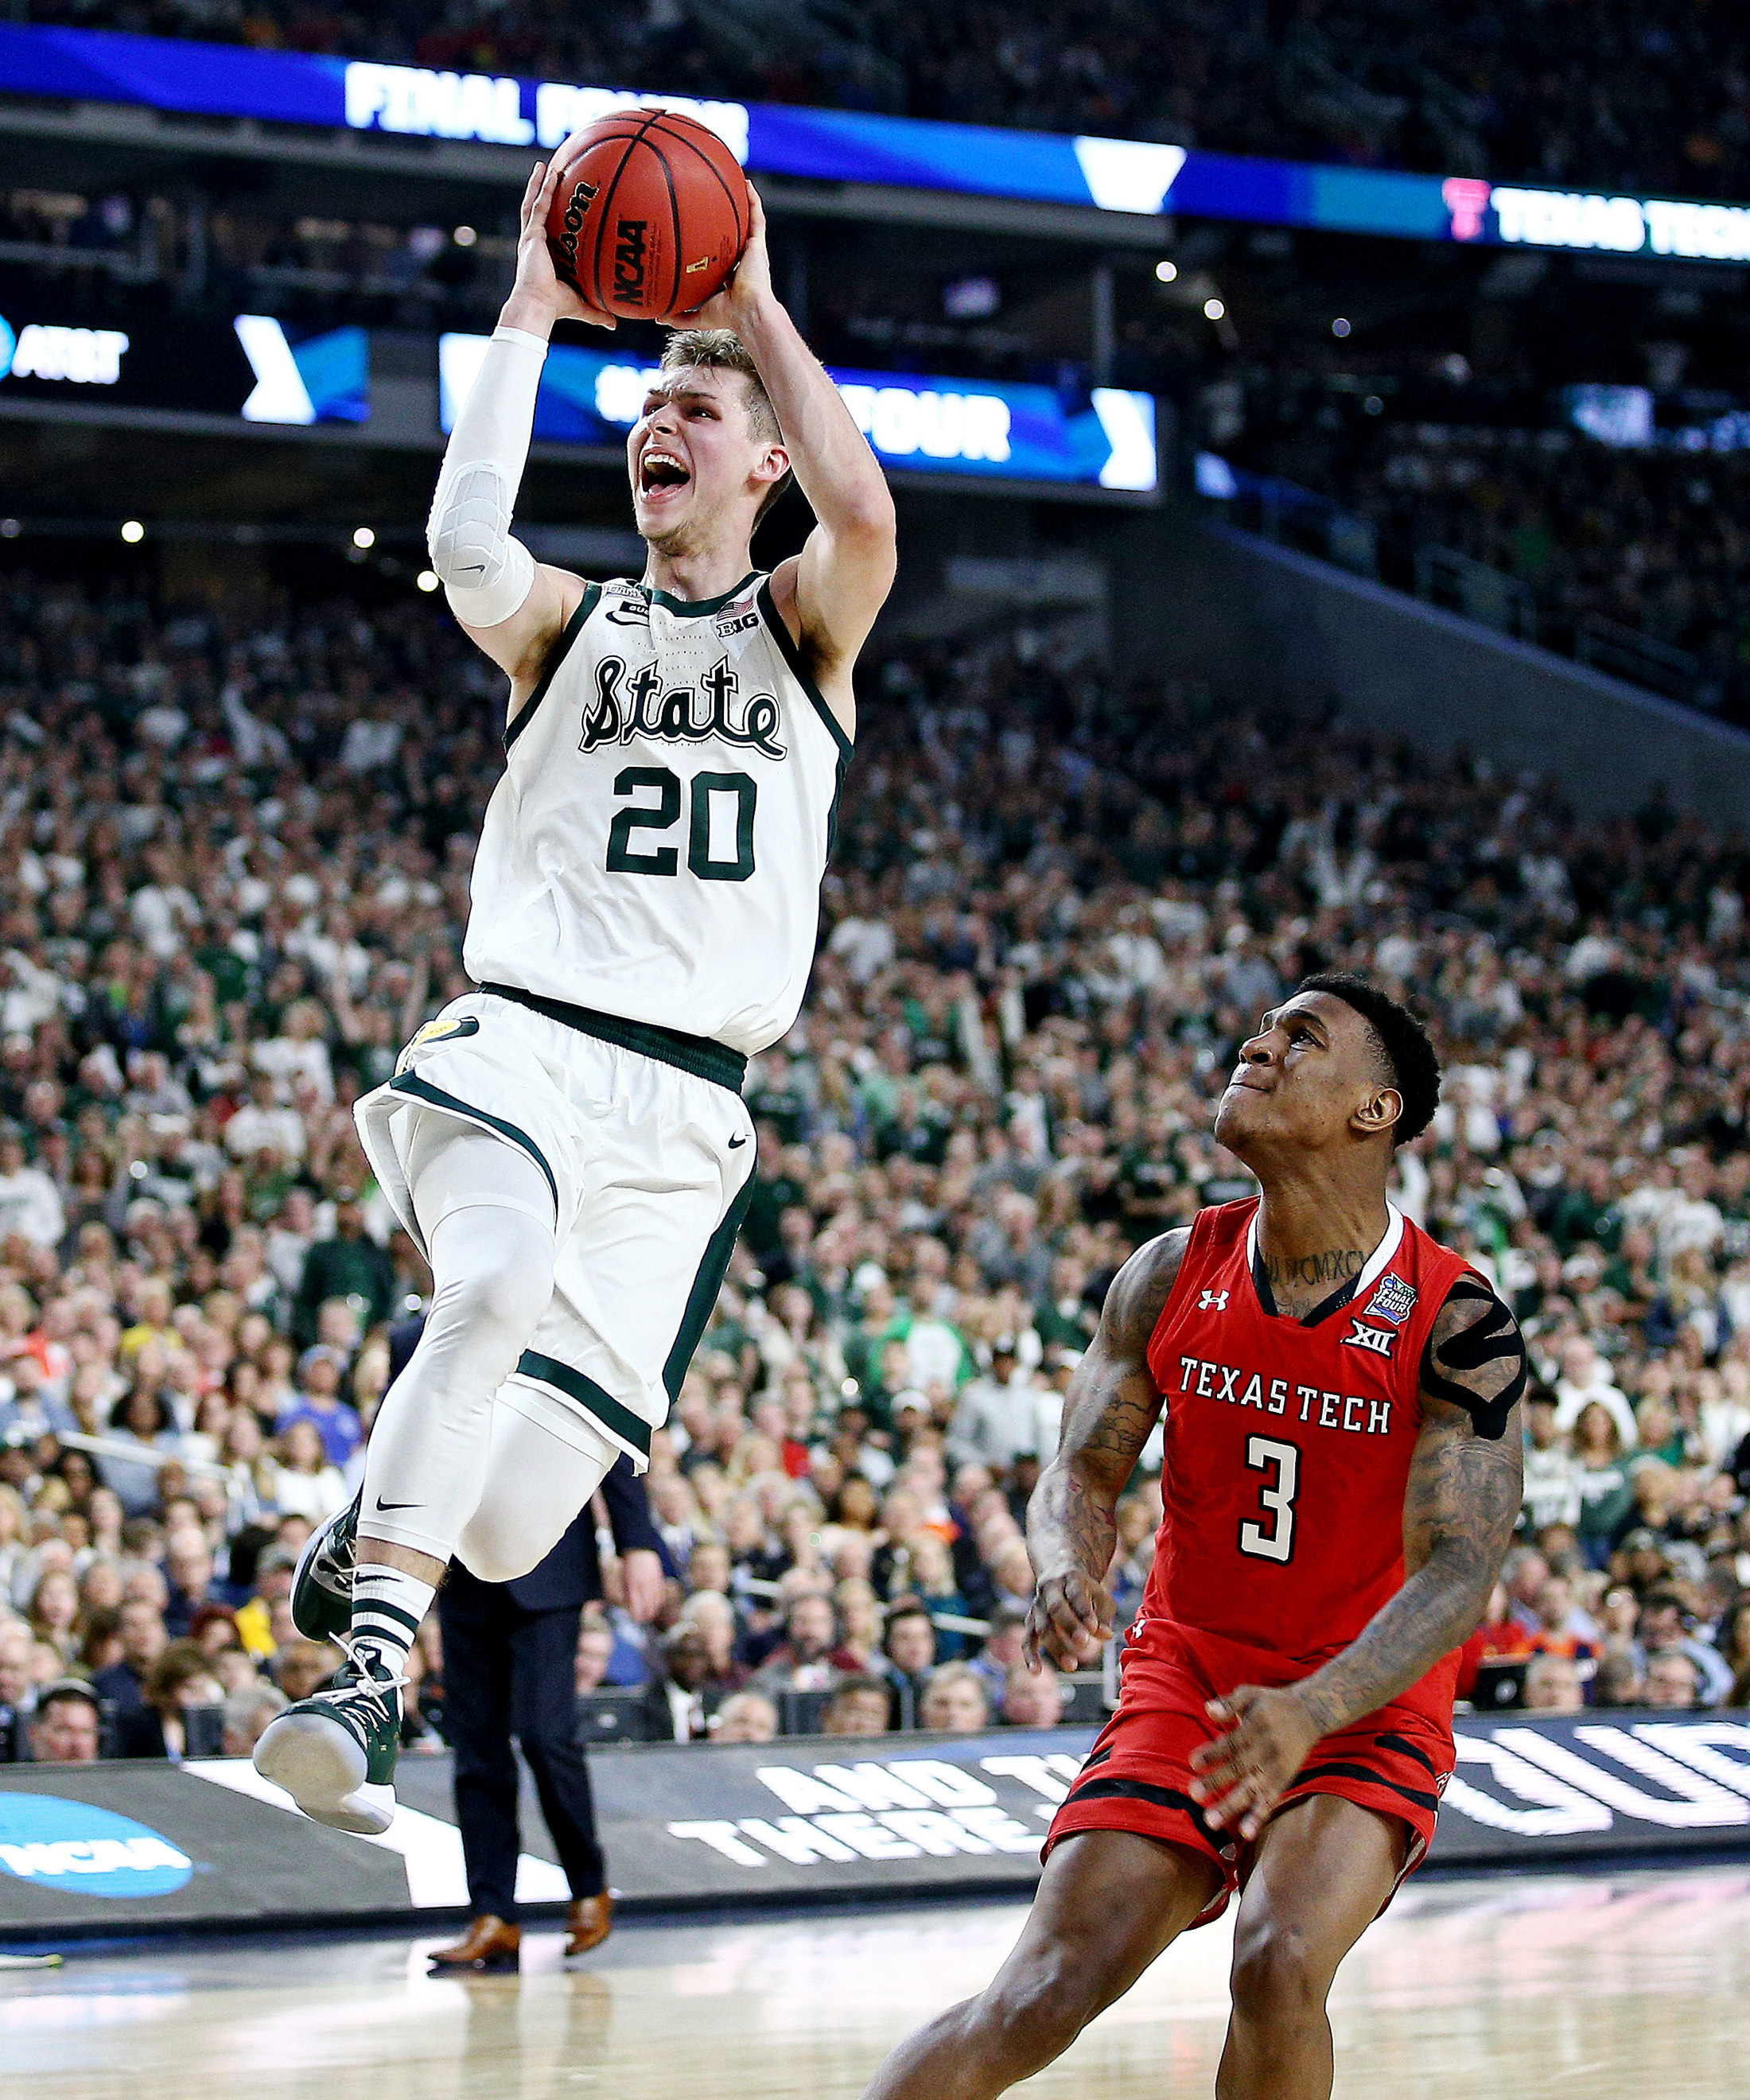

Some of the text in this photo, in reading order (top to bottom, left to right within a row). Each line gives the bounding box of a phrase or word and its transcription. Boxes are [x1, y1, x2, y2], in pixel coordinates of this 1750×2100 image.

[345, 60, 536, 146] FINAL
[1490, 187, 1645, 252] TEXAS
[613, 220, 648, 306] NCAA
[578, 654, 788, 761] State
[606, 766, 757, 881] 20
[1375, 1296, 1407, 1313] FOUR
[1381, 1289, 1411, 1305] FINAL
[1344, 1319, 1396, 1357] XII
[1180, 1355, 1391, 1433] TEXAS TECH
[1239, 1434, 1301, 1564] 3
[756, 1758, 998, 1814] AND
[667, 1806, 1048, 1868] THERE
